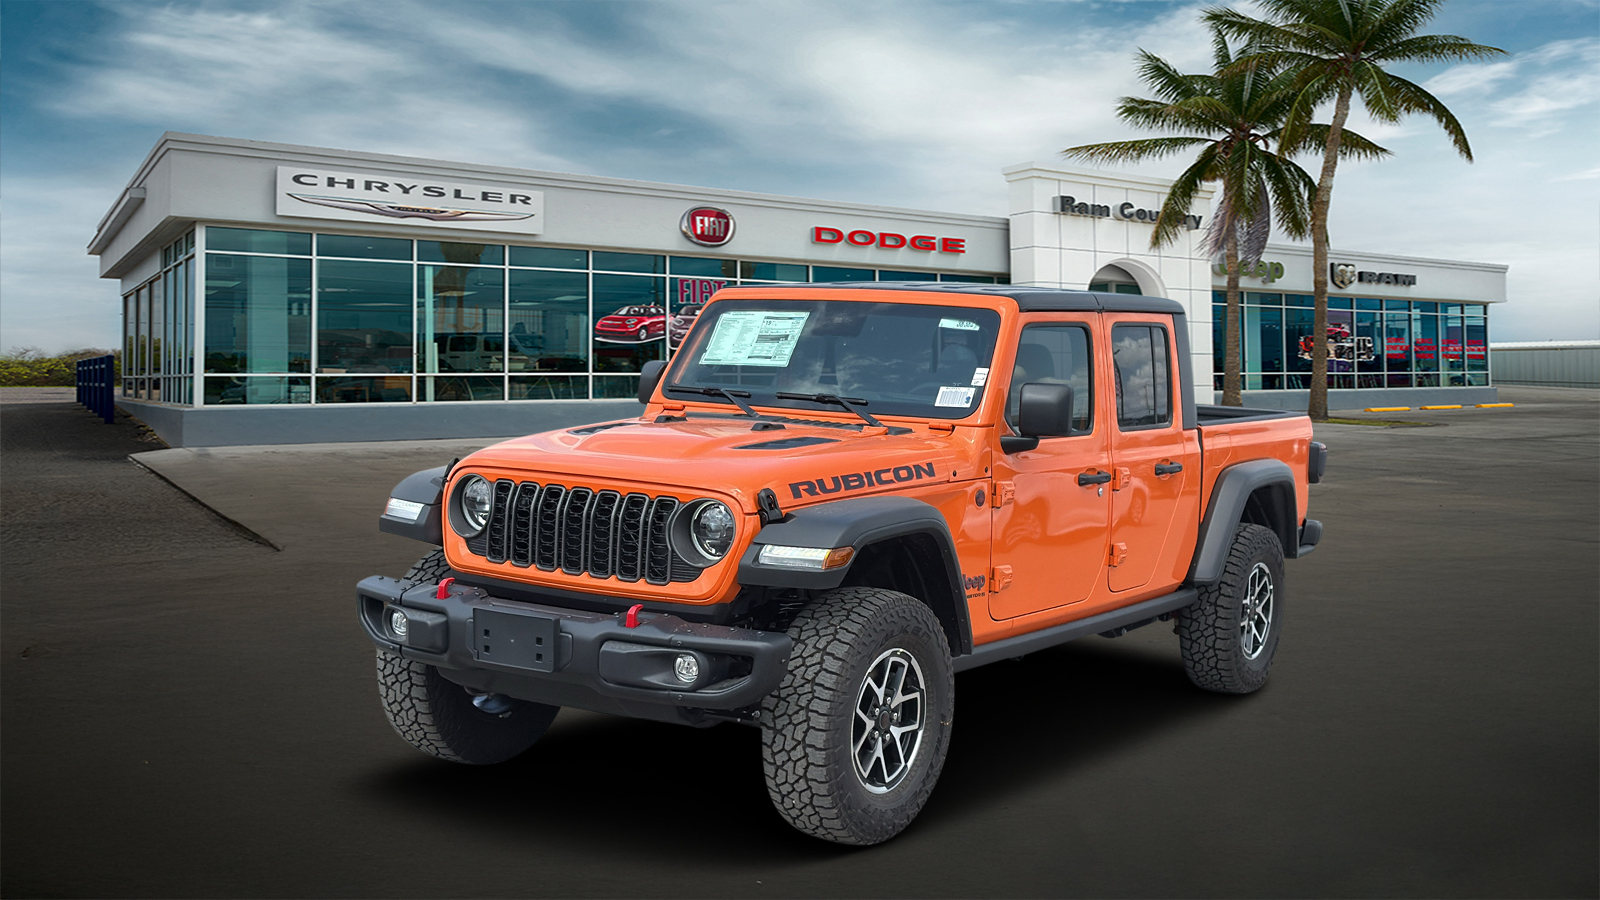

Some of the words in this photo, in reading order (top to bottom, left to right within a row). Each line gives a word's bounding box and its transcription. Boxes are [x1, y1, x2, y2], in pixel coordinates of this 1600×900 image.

[292, 173, 532, 206] CHRYSLER
[695, 216, 728, 237] FIAT
[1058, 195, 1110, 217] Ram
[1119, 202, 1203, 230] Coury
[813, 226, 966, 254] DODGE
[1358, 271, 1416, 286] RAM
[788, 462, 936, 499] RUBICON
